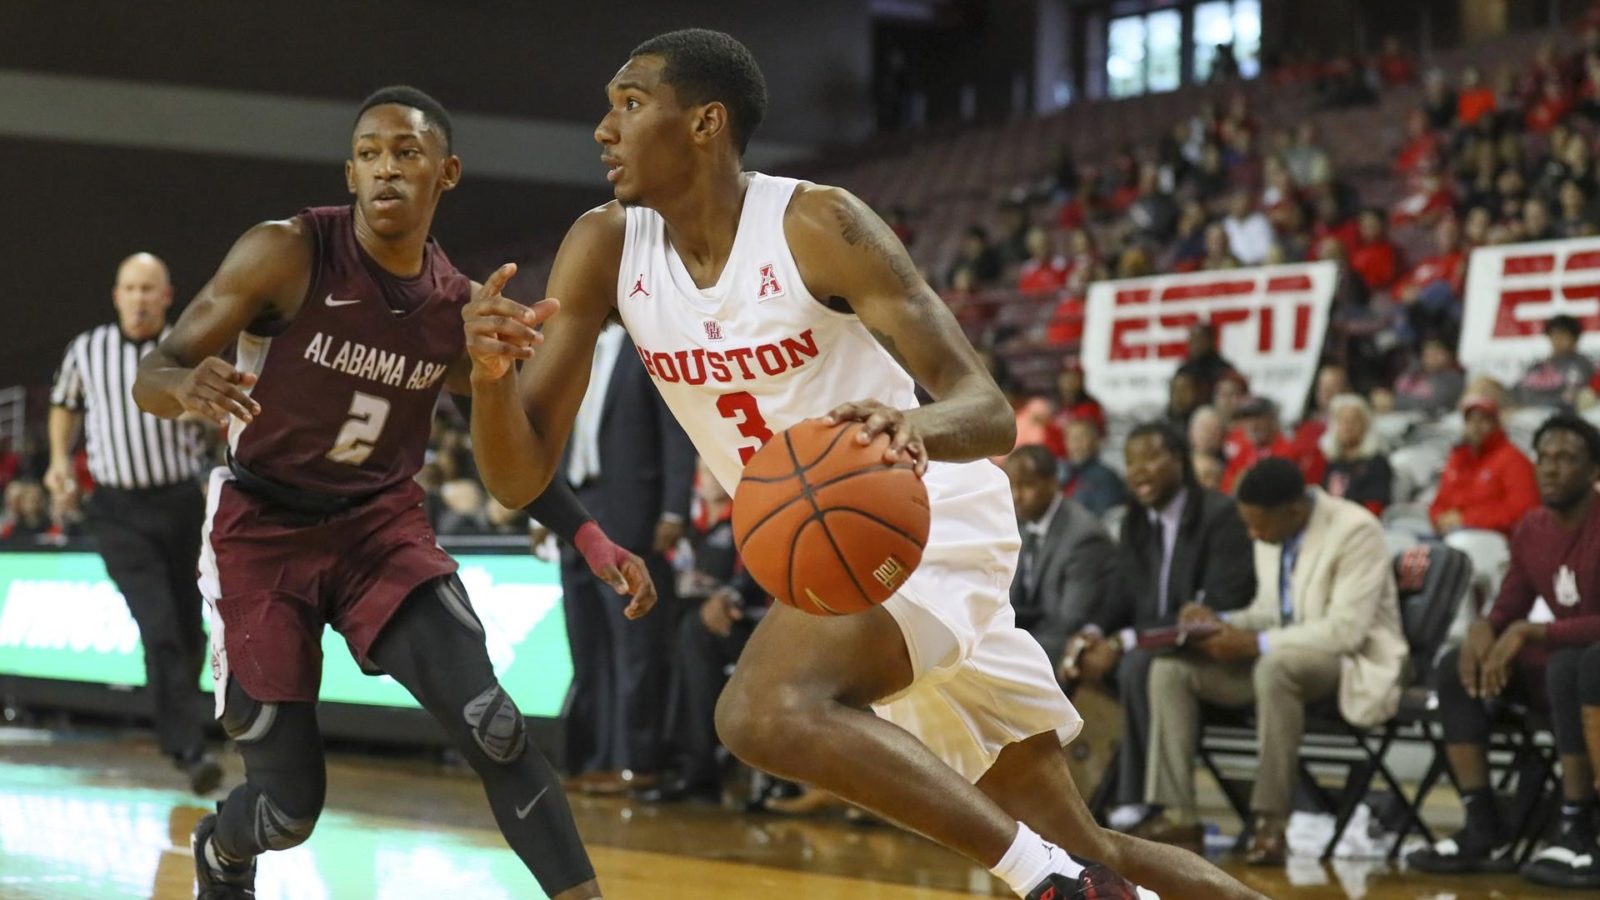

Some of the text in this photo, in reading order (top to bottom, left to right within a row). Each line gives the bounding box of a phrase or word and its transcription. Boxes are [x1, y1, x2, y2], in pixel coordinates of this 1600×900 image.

[1109, 274, 1312, 361] ESPN
[303, 331, 448, 390] ALABAMA A&M
[637, 328, 819, 386] HOUSTON
[325, 390, 391, 467] 2
[716, 391, 774, 467] 3
